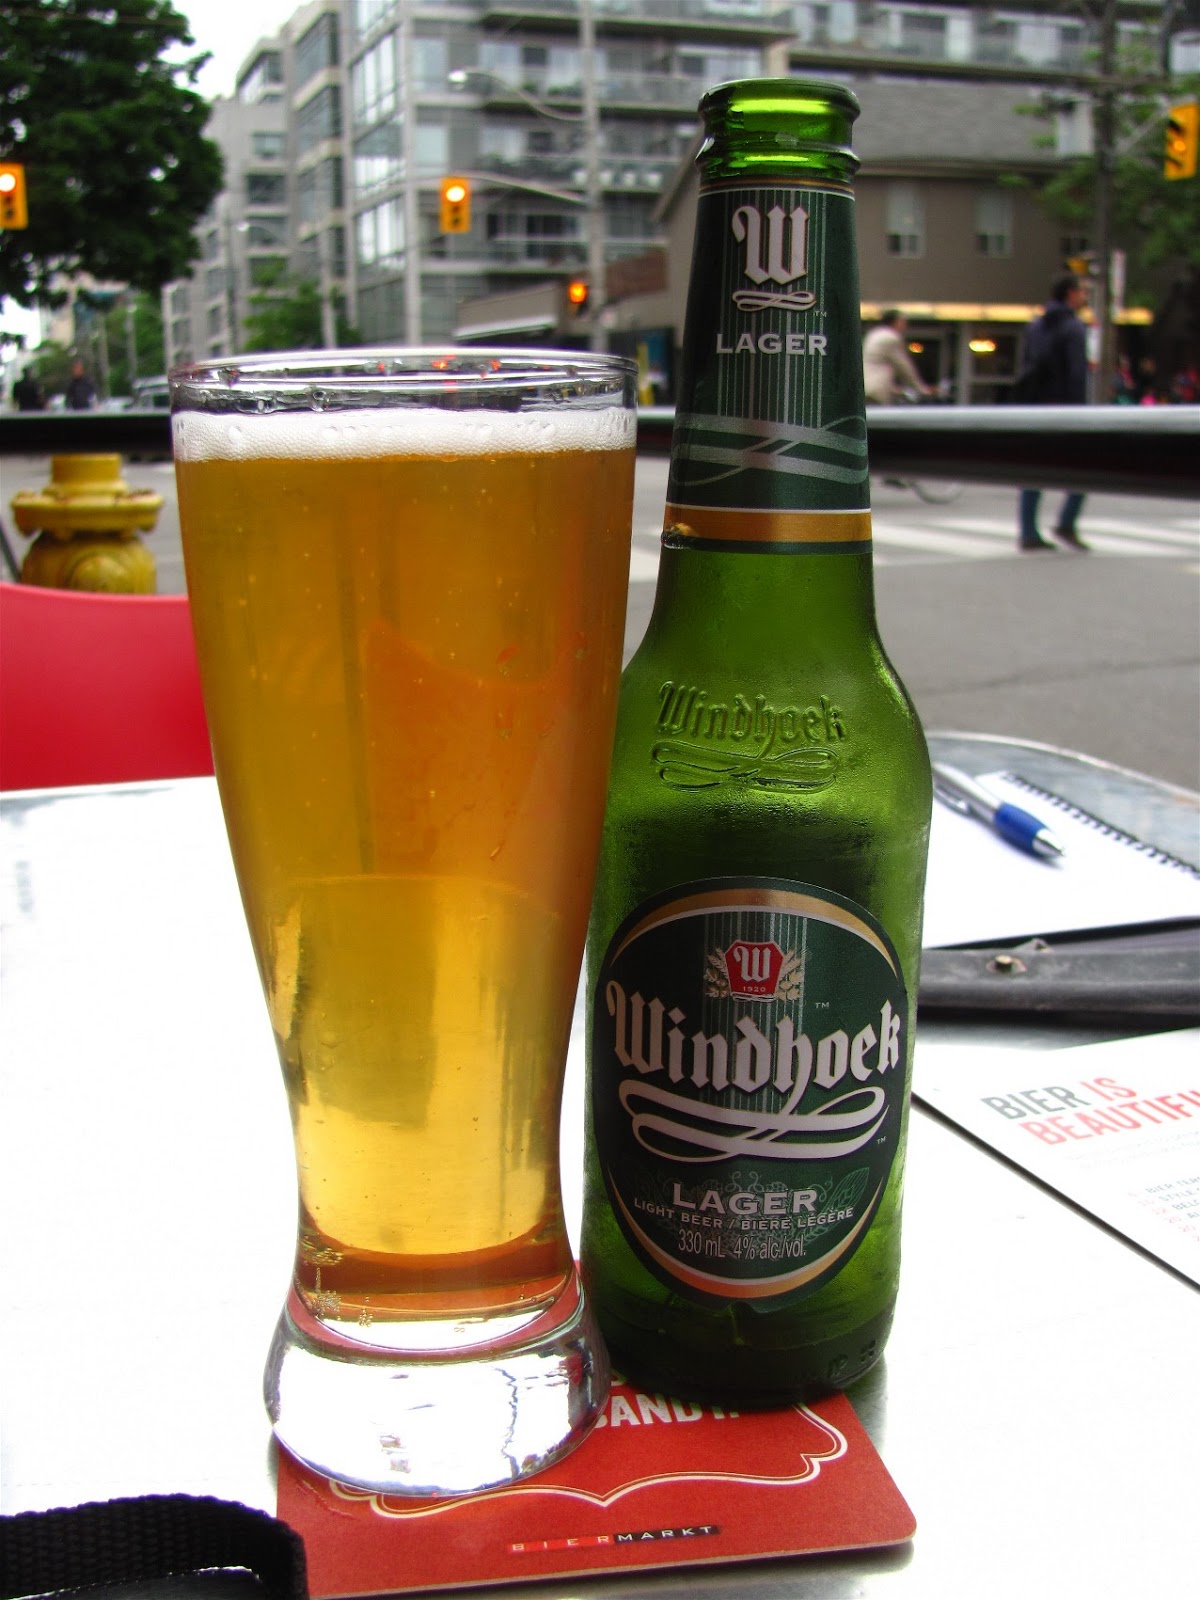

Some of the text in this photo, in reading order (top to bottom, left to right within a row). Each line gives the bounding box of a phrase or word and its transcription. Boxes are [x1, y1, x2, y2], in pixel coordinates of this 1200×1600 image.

[732, 206, 809, 284] W
[716, 333, 828, 356] LAGER
[656, 680, 847, 745] Windhoek
[733, 946, 772, 982] W
[606, 980, 900, 1100] Windhoek
[980, 1077, 1137, 1119] BIER IS
[634, 1197, 674, 1219] LIGHT
[681, 1213, 723, 1229] BEER
[741, 1217, 791, 1230] BIÈRE
[797, 1207, 854, 1228] LÉGÈRE
[672, 1182, 818, 1215] LAGER
[678, 1229, 702, 1254] 330
[705, 1236, 725, 1258] mL
[733, 1237, 755, 1260] 4%
